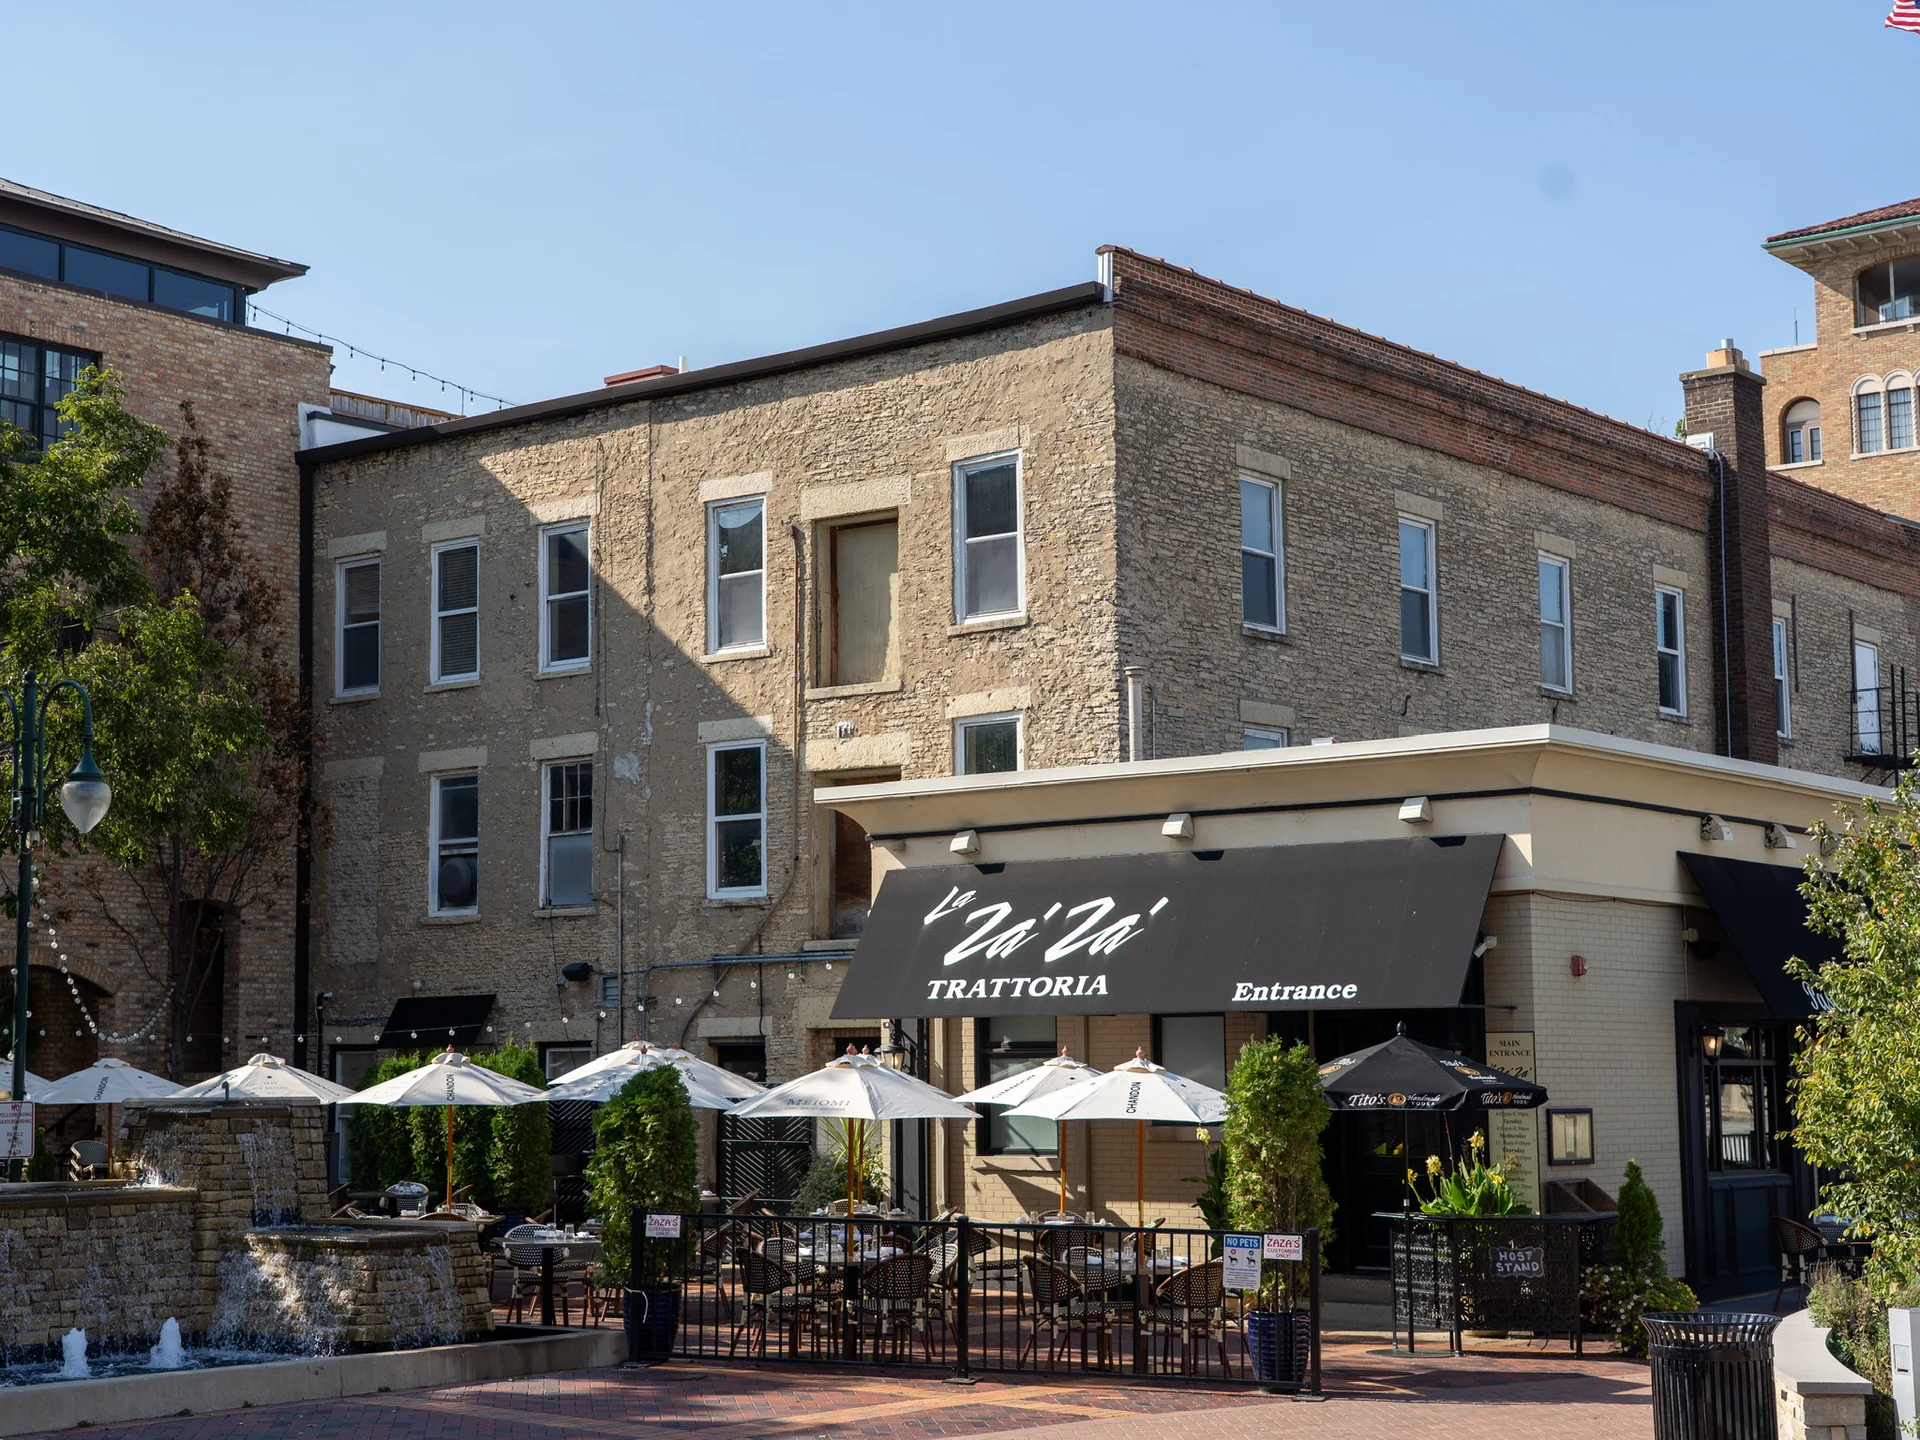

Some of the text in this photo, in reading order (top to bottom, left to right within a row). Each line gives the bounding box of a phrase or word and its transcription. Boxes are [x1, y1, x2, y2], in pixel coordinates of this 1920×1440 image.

[923, 885, 977, 926] La
[927, 974, 1110, 1000] TRATTORIA
[1231, 982, 1359, 1002] Entrance
[94, 1076, 109, 1101] CHANDON
[446, 1073, 455, 1101] CHANDON
[1126, 1081, 1142, 1114] CHANDON
[1407, 1093, 1441, 1102] Handmade
[11, 1104, 20, 1112] NO
[648, 1218, 678, 1227] ZAZA'S
[1226, 1237, 1259, 1248] NO PETS
[1266, 1238, 1301, 1249] ZAZA'S
[1498, 1251, 1533, 1262] HOST
[1495, 1261, 1540, 1272] STAND
